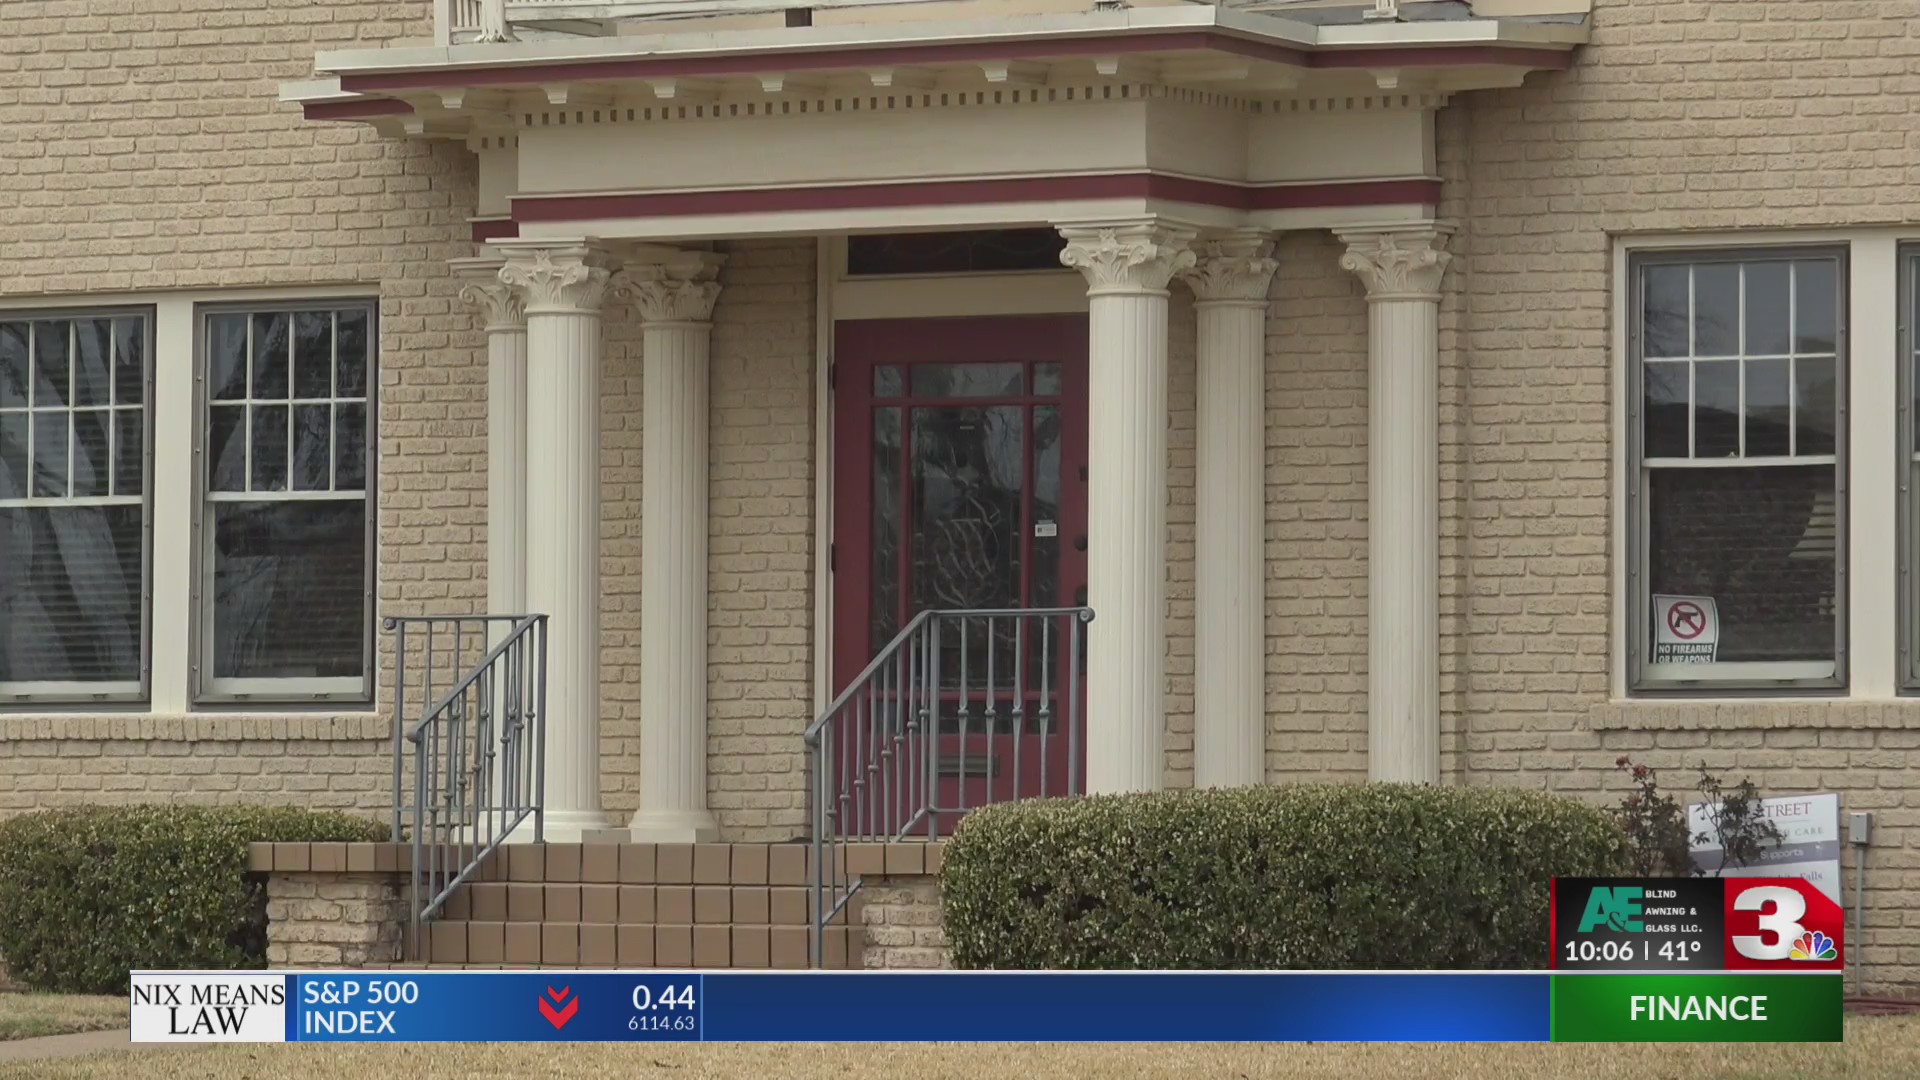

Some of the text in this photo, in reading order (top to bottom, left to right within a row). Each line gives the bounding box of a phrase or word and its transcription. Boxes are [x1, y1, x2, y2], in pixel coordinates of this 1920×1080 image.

[1658, 644, 1713, 654] NO FIREARMS
[1672, 654, 1711, 664] WEAPONS
[1756, 801, 1812, 818] TREET
[1760, 848, 1804, 860] Spports
